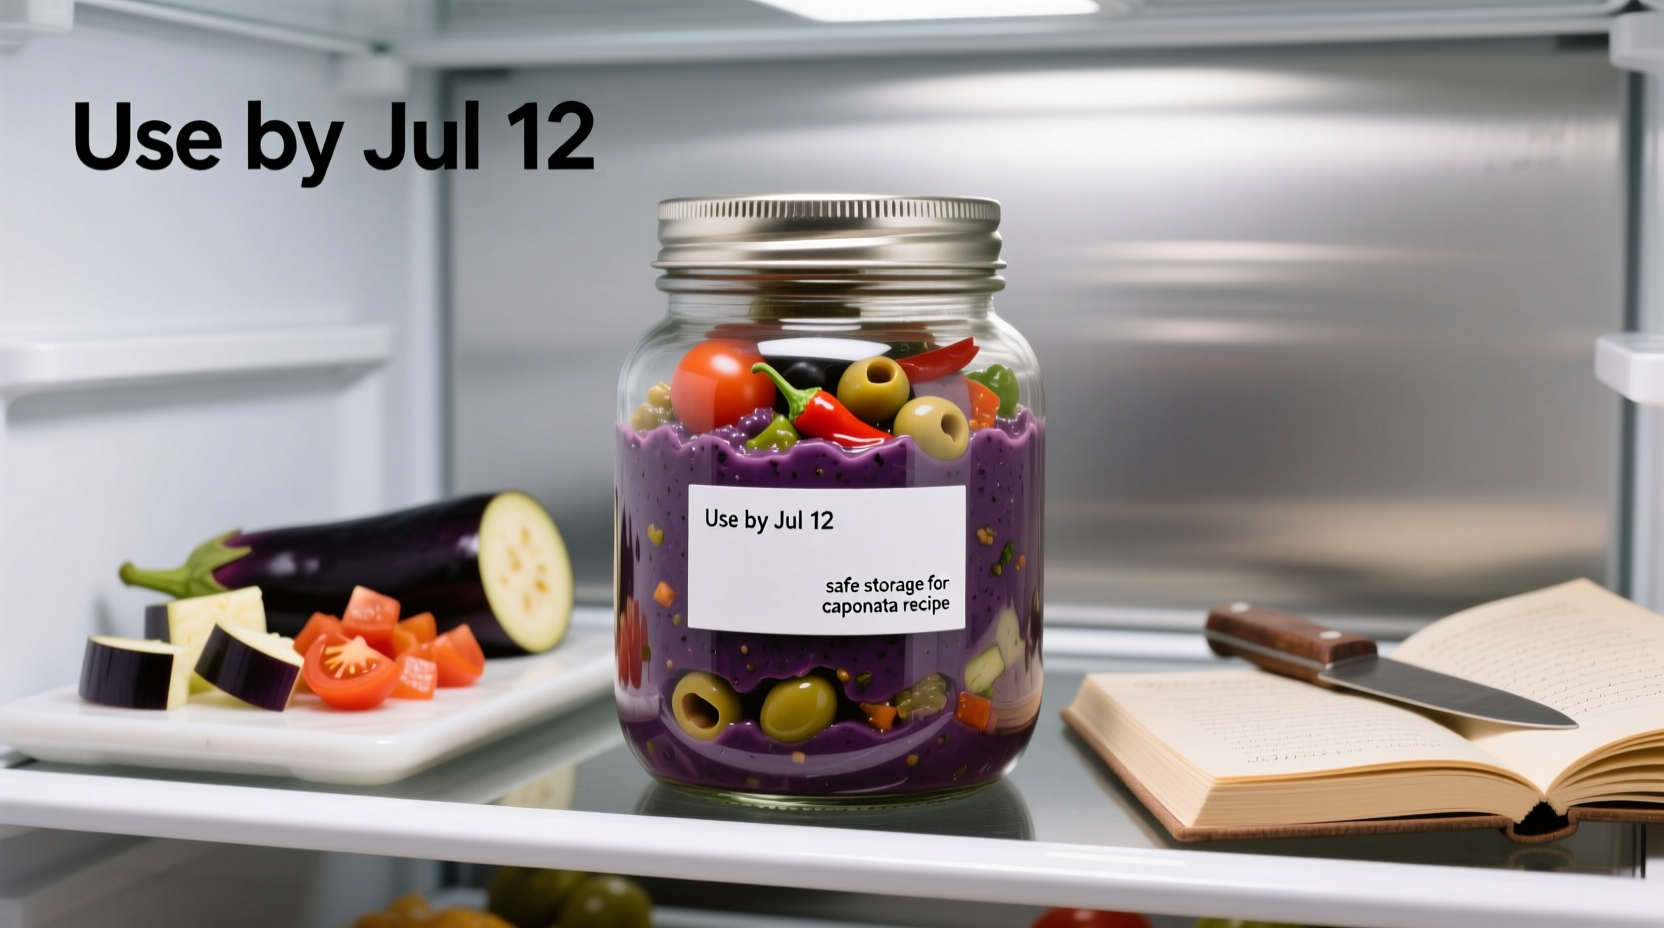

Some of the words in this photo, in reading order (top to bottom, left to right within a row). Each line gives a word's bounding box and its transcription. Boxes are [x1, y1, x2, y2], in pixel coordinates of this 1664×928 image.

[705, 508, 739, 528] Use
[745, 509, 769, 535] by
[773, 509, 803, 530] Jul
[810, 510, 834, 530] 12
[825, 576, 860, 594] safe
[864, 577, 925, 596] storage
[927, 574, 950, 591] for
[821, 598, 898, 618] caponata
[902, 596, 950, 616] recipe
